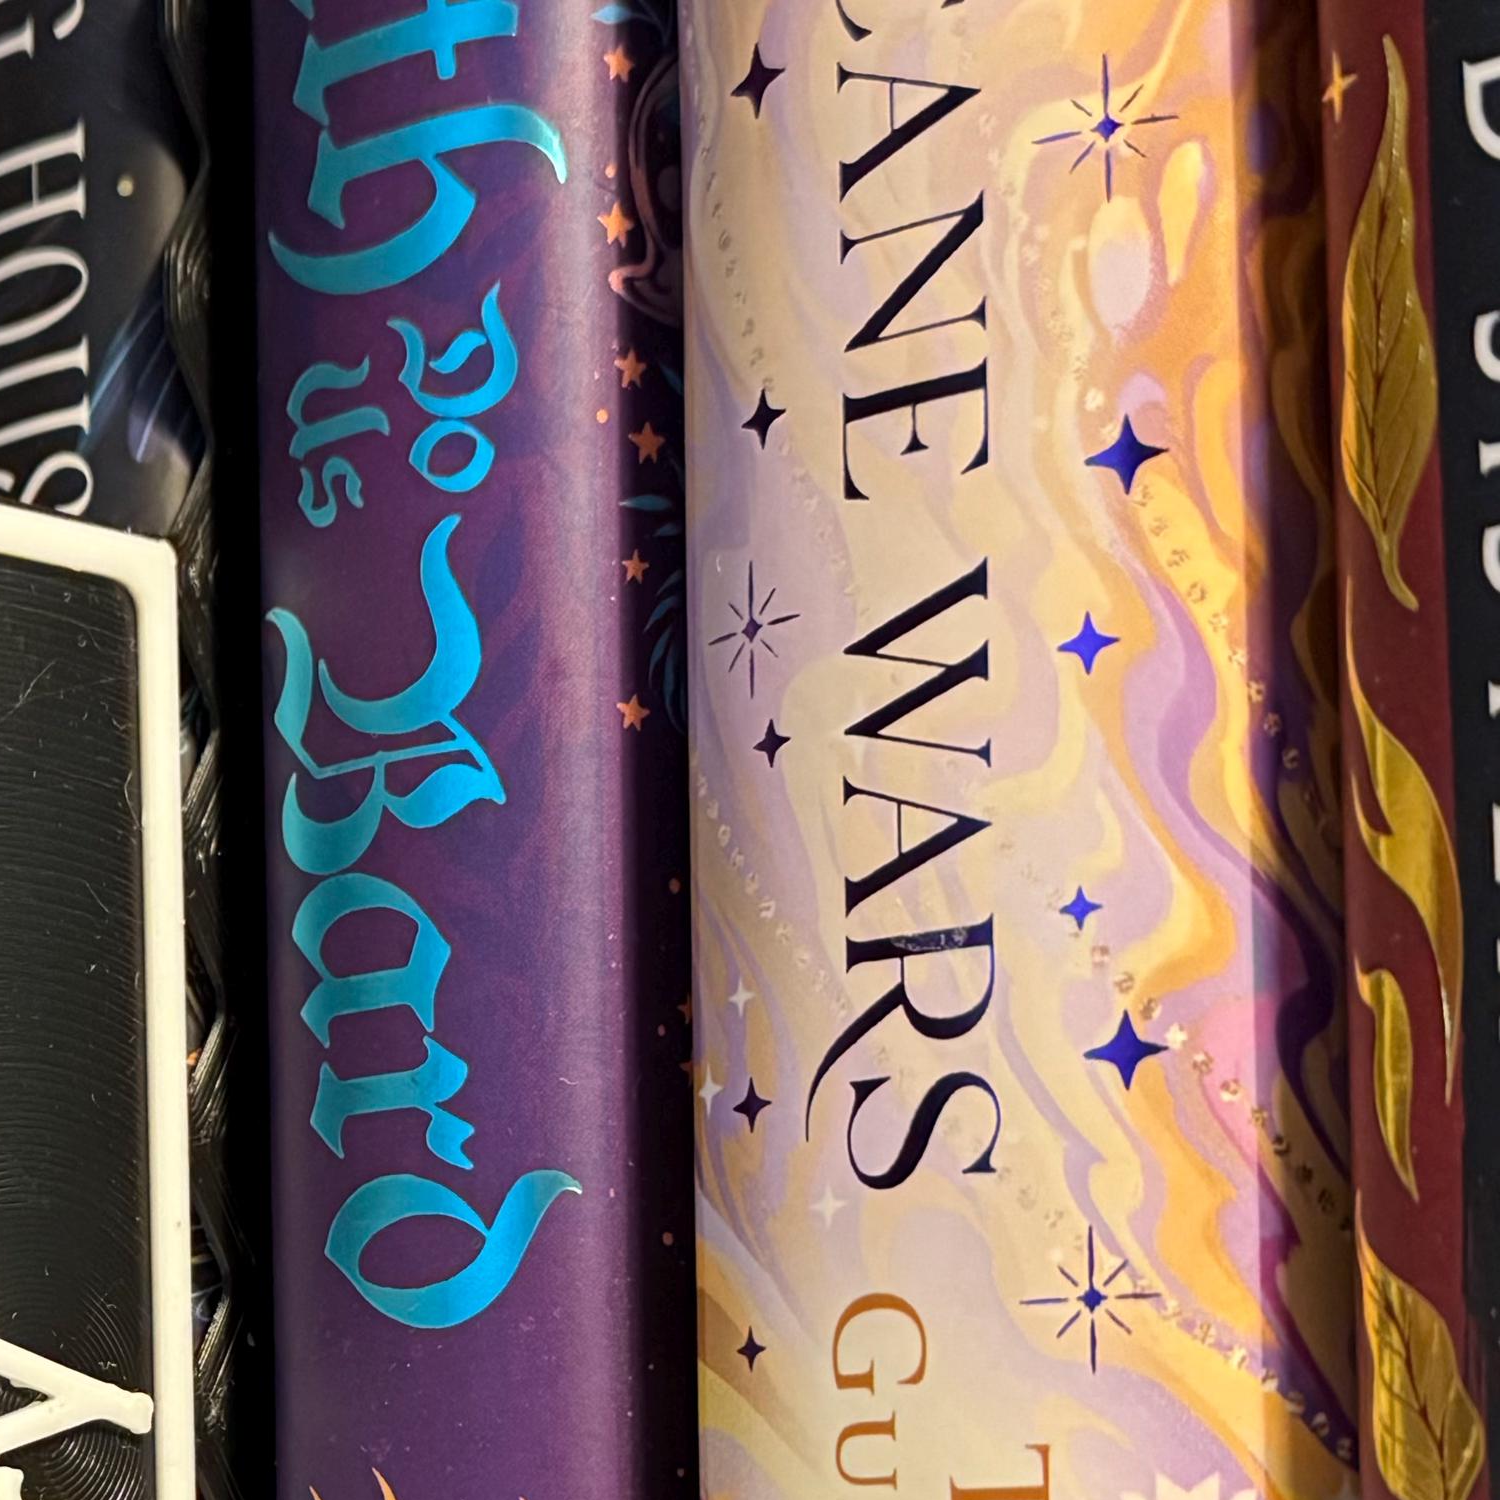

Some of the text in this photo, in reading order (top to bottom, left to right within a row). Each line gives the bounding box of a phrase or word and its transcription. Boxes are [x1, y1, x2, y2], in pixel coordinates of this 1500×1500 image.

[286, 355, 390, 529] Us
[386, 281, 519, 493] Do
[265, 513, 583, 1331] Bard
[805, 557, 1002, 1191] WARS
